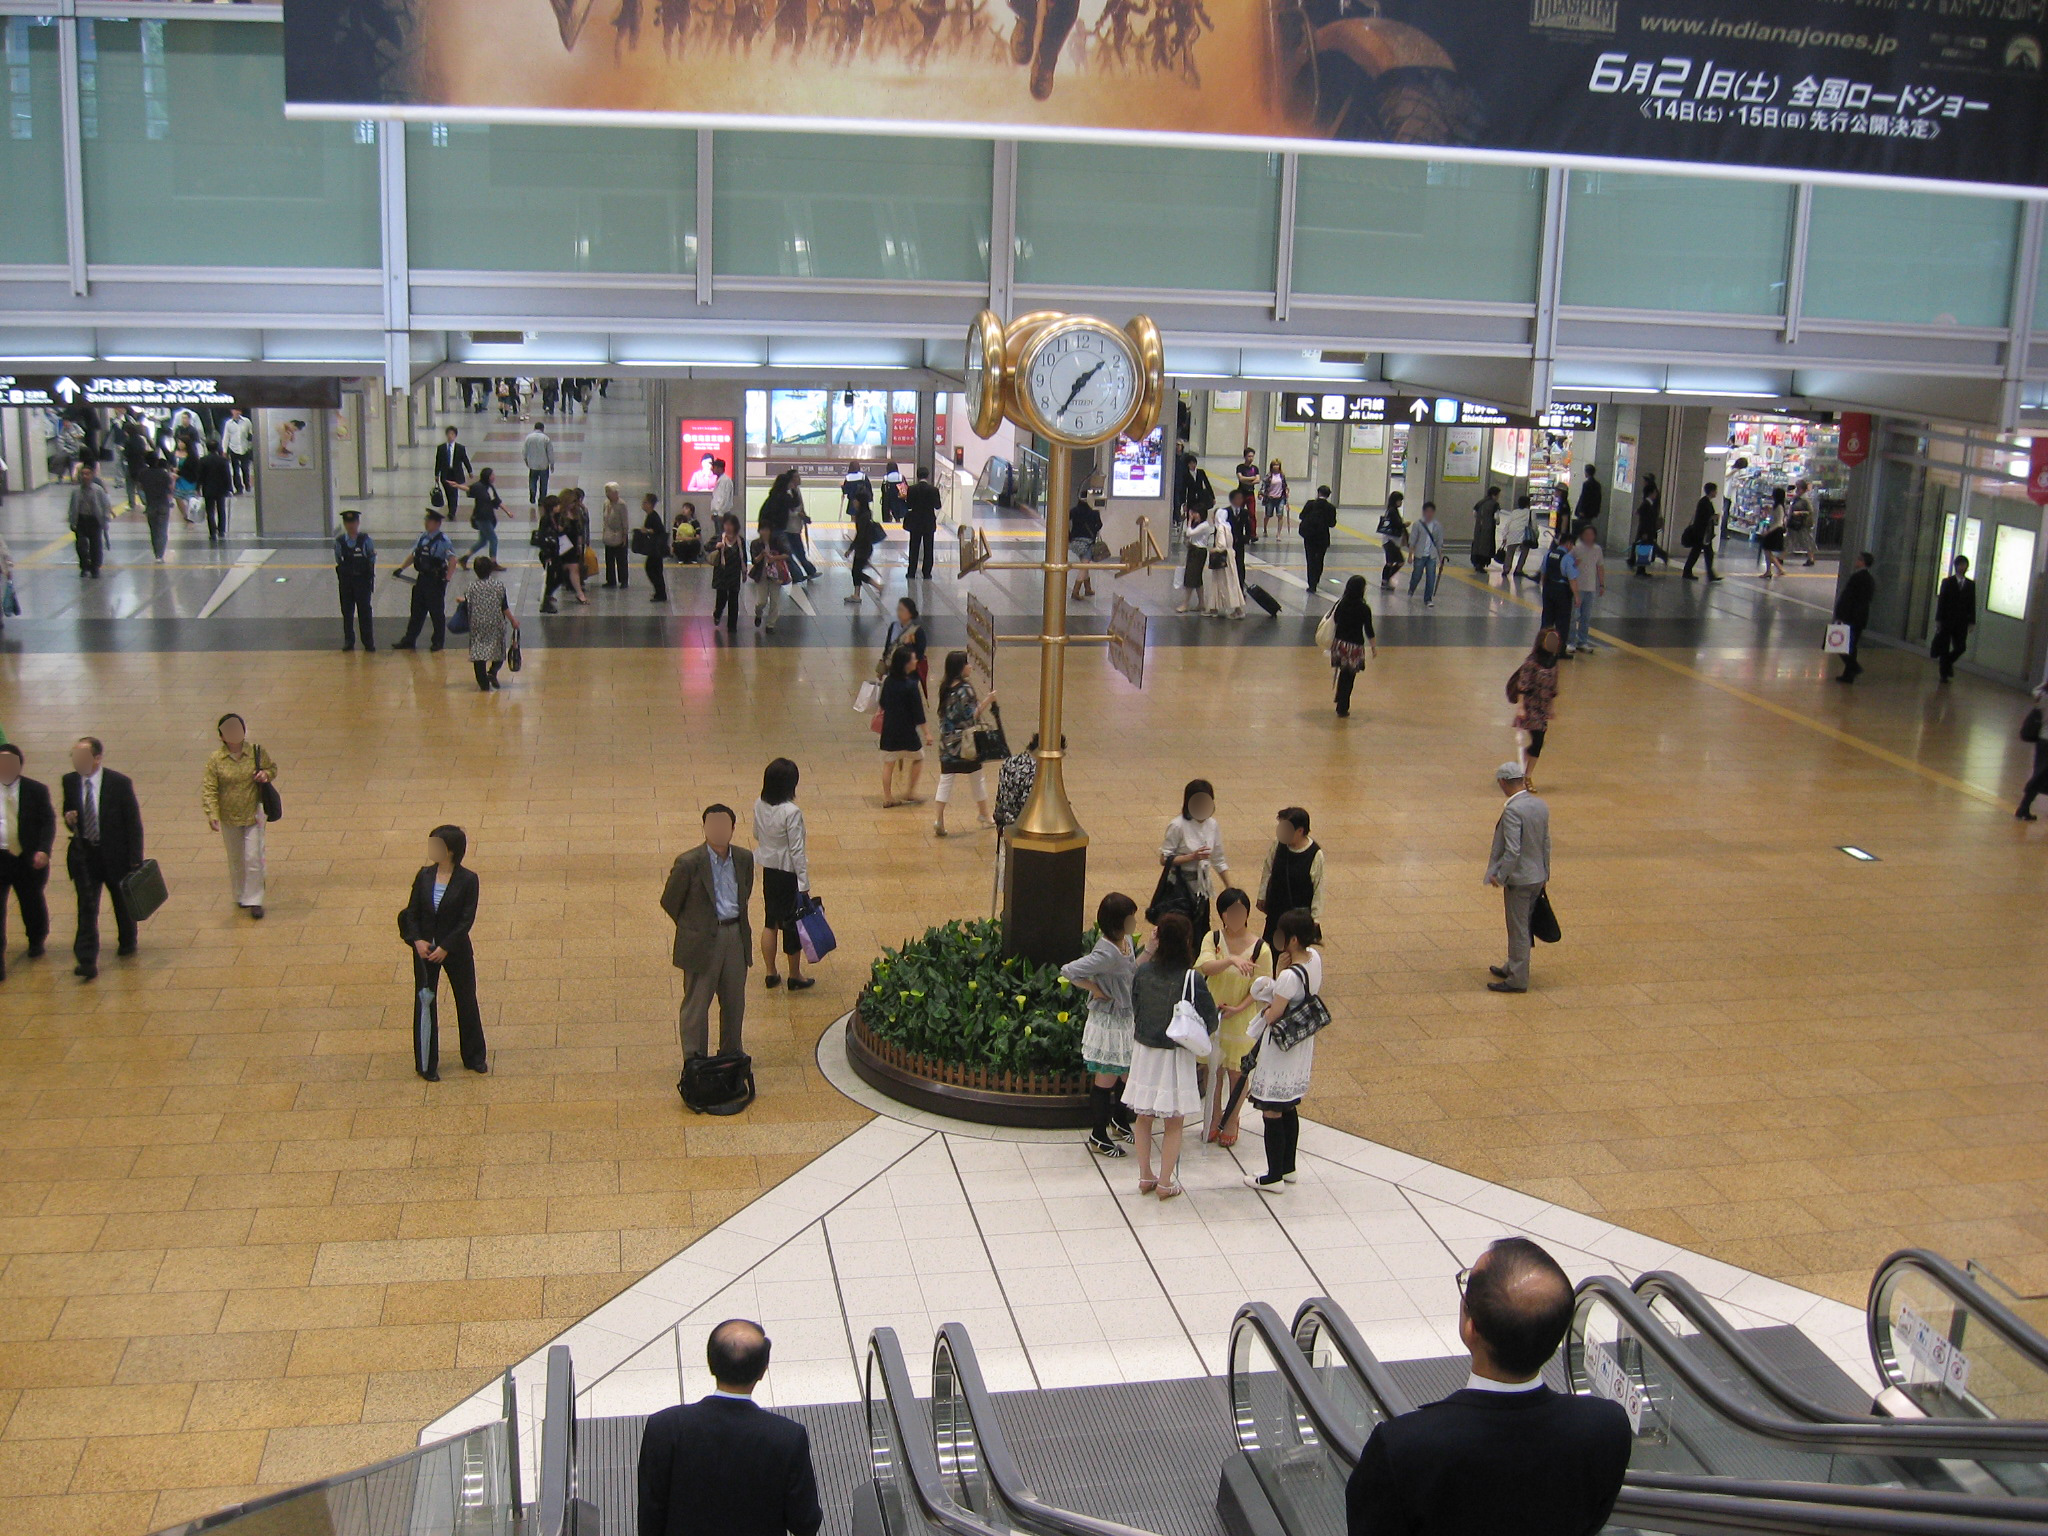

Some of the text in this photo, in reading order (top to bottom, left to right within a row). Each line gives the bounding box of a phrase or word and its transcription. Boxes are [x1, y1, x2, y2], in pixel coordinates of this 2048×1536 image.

[1640, 12, 1899, 56] www.indianajones.jp
[1588, 52, 1990, 118] 6月21日(土) 全国ロードショー
[1056, 339, 1068, 352] 11
[1076, 334, 1090, 349] 12
[1100, 339, 1104, 354] 1
[1042, 352, 1056, 367] 10
[1112, 354, 1121, 368] 2
[84, 378, 217, 393] JR全線きっぷうりば
[1036, 374, 1045, 387] 9
[1117, 376, 1125, 390] 3
[85, 394, 142, 402] Shinkansen
[143, 395, 162, 403] and
[163, 395, 177, 403] JR
[1041, 395, 1050, 409] 8
[1110, 396, 1117, 410] 4
[1075, 416, 1084, 429] 6
[1096, 410, 1104, 424] 5
[1461, 414, 1507, 424] Shinkansen
